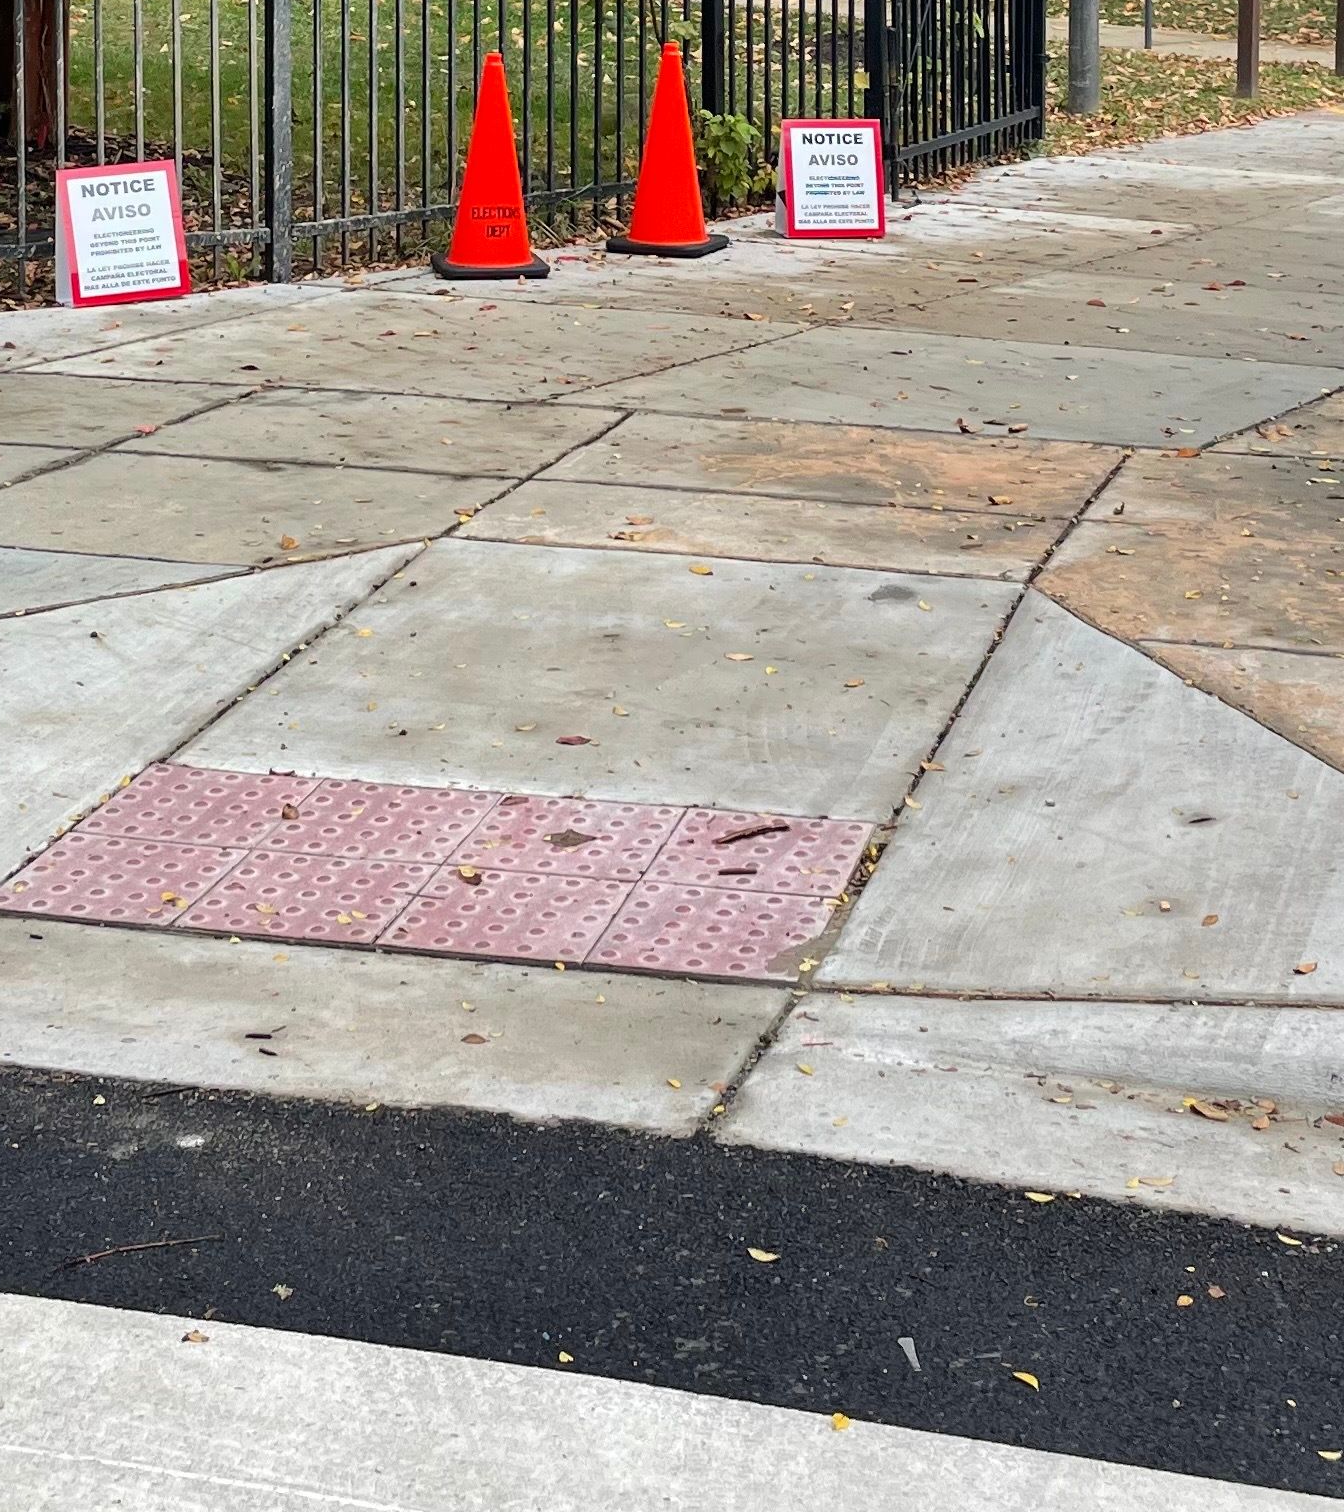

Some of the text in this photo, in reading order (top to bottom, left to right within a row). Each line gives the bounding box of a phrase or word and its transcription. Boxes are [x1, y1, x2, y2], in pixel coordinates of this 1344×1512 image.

[802, 134, 863, 144] NOTICE
[809, 154, 858, 165] AVISO
[81, 179, 155, 198] NOTICE
[92, 204, 151, 222] AVISO
